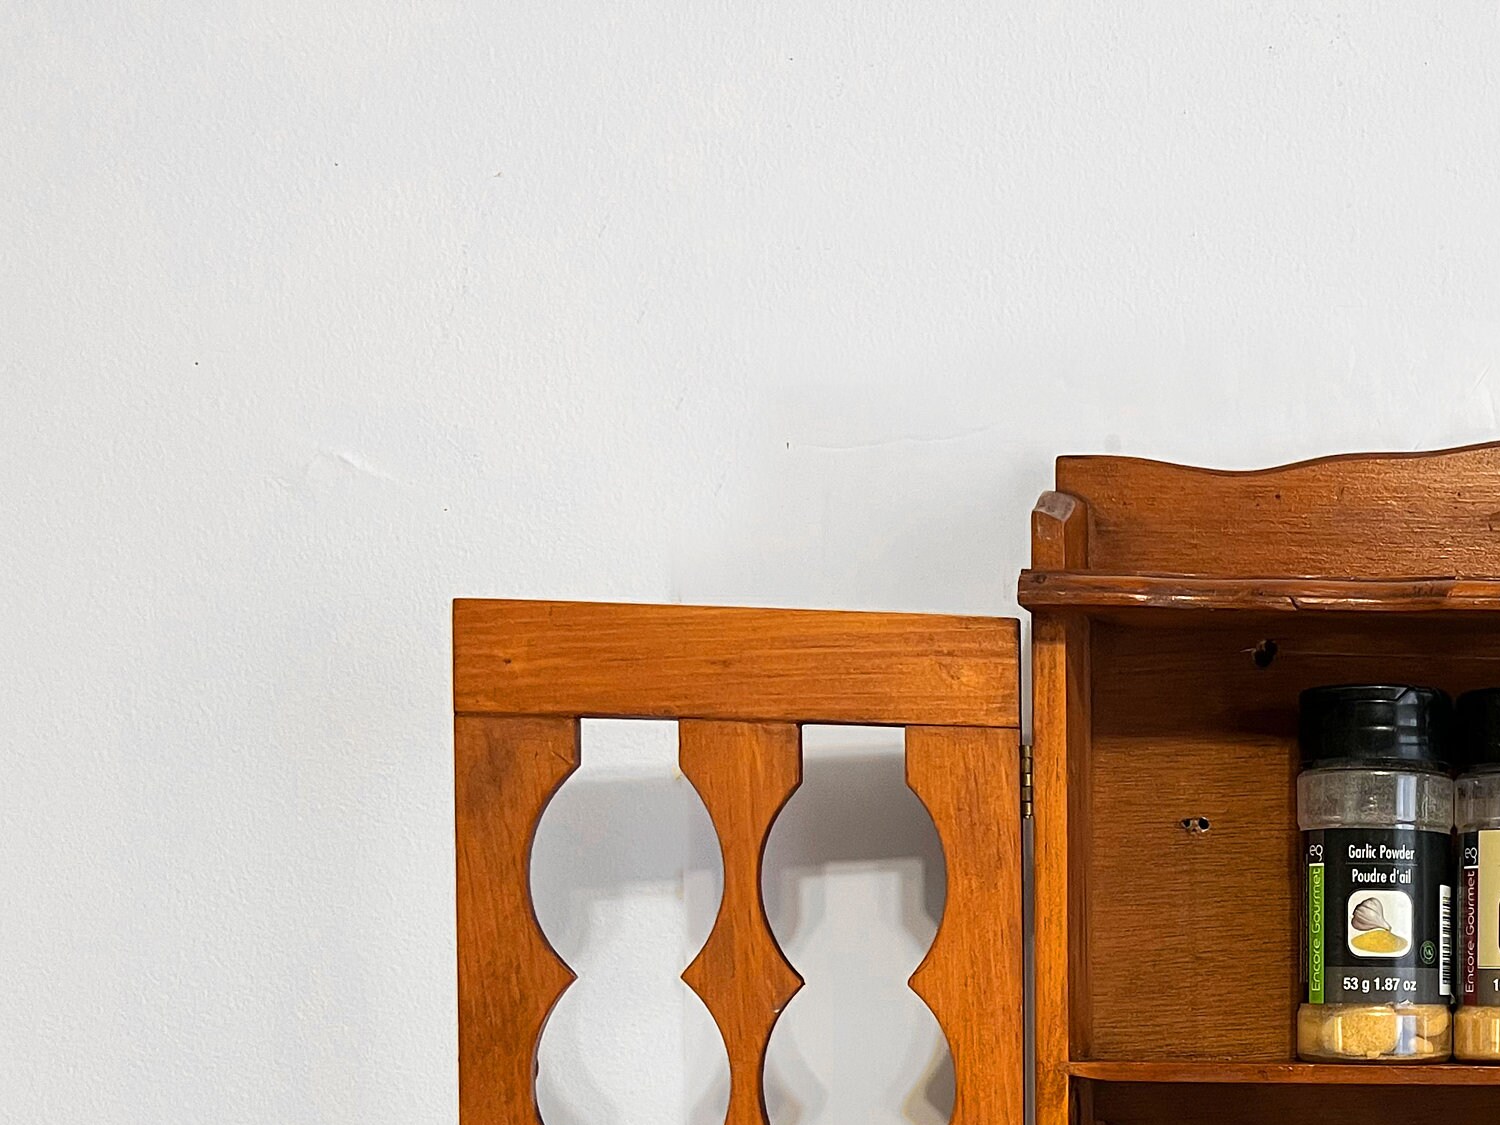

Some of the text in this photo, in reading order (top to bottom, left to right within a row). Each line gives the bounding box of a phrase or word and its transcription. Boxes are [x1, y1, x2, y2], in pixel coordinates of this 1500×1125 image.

[1348, 843, 1414, 860] Garlic Powder
[1352, 868, 1412, 884] Poudre d'ail
[1312, 868, 1321, 991] Encore Gourmet
[1465, 871, 1475, 993] Encore Gourmet
[1343, 977, 1417, 993] 53 g 1.87 oz
